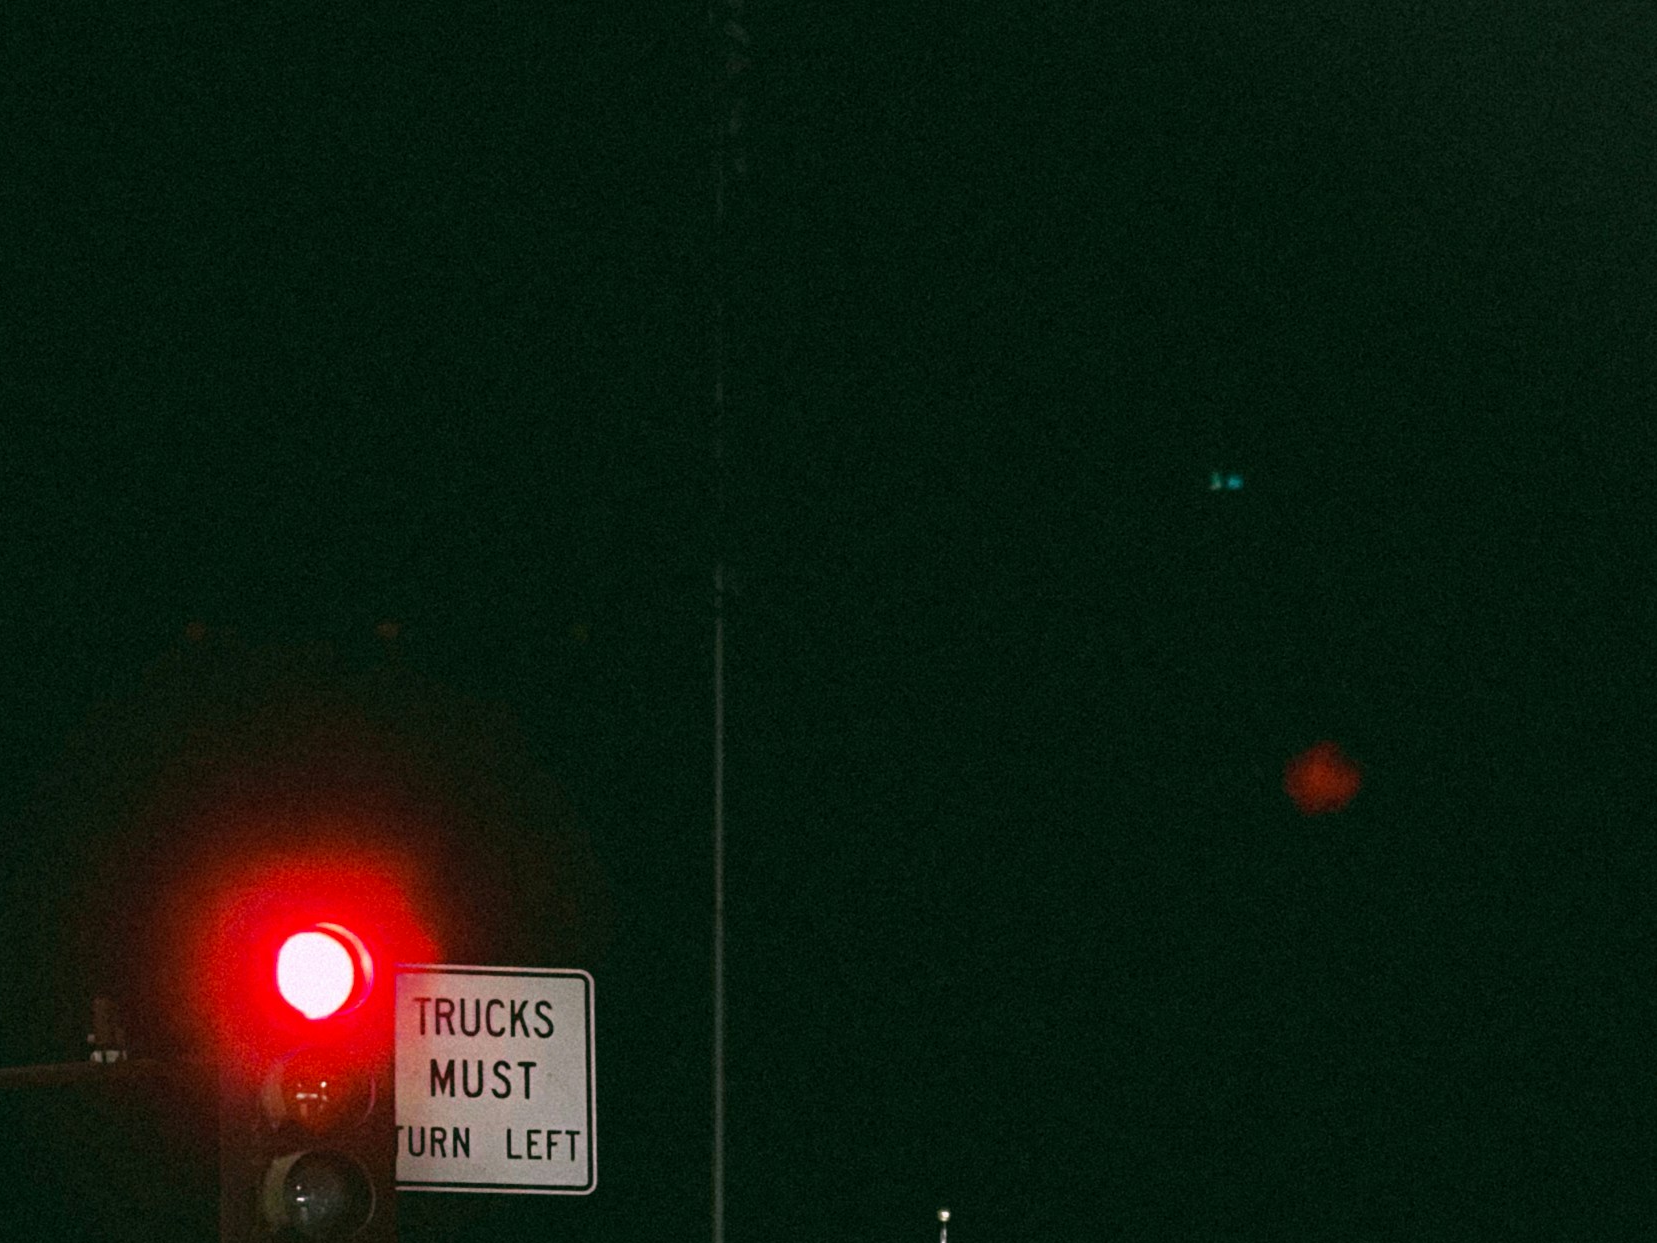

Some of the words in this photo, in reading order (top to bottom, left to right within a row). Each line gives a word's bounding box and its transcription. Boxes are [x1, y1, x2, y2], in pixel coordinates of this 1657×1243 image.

[412, 997, 555, 1039] TRUCKS
[430, 1059, 537, 1100] MUST
[506, 1128, 581, 1162] LEFT
